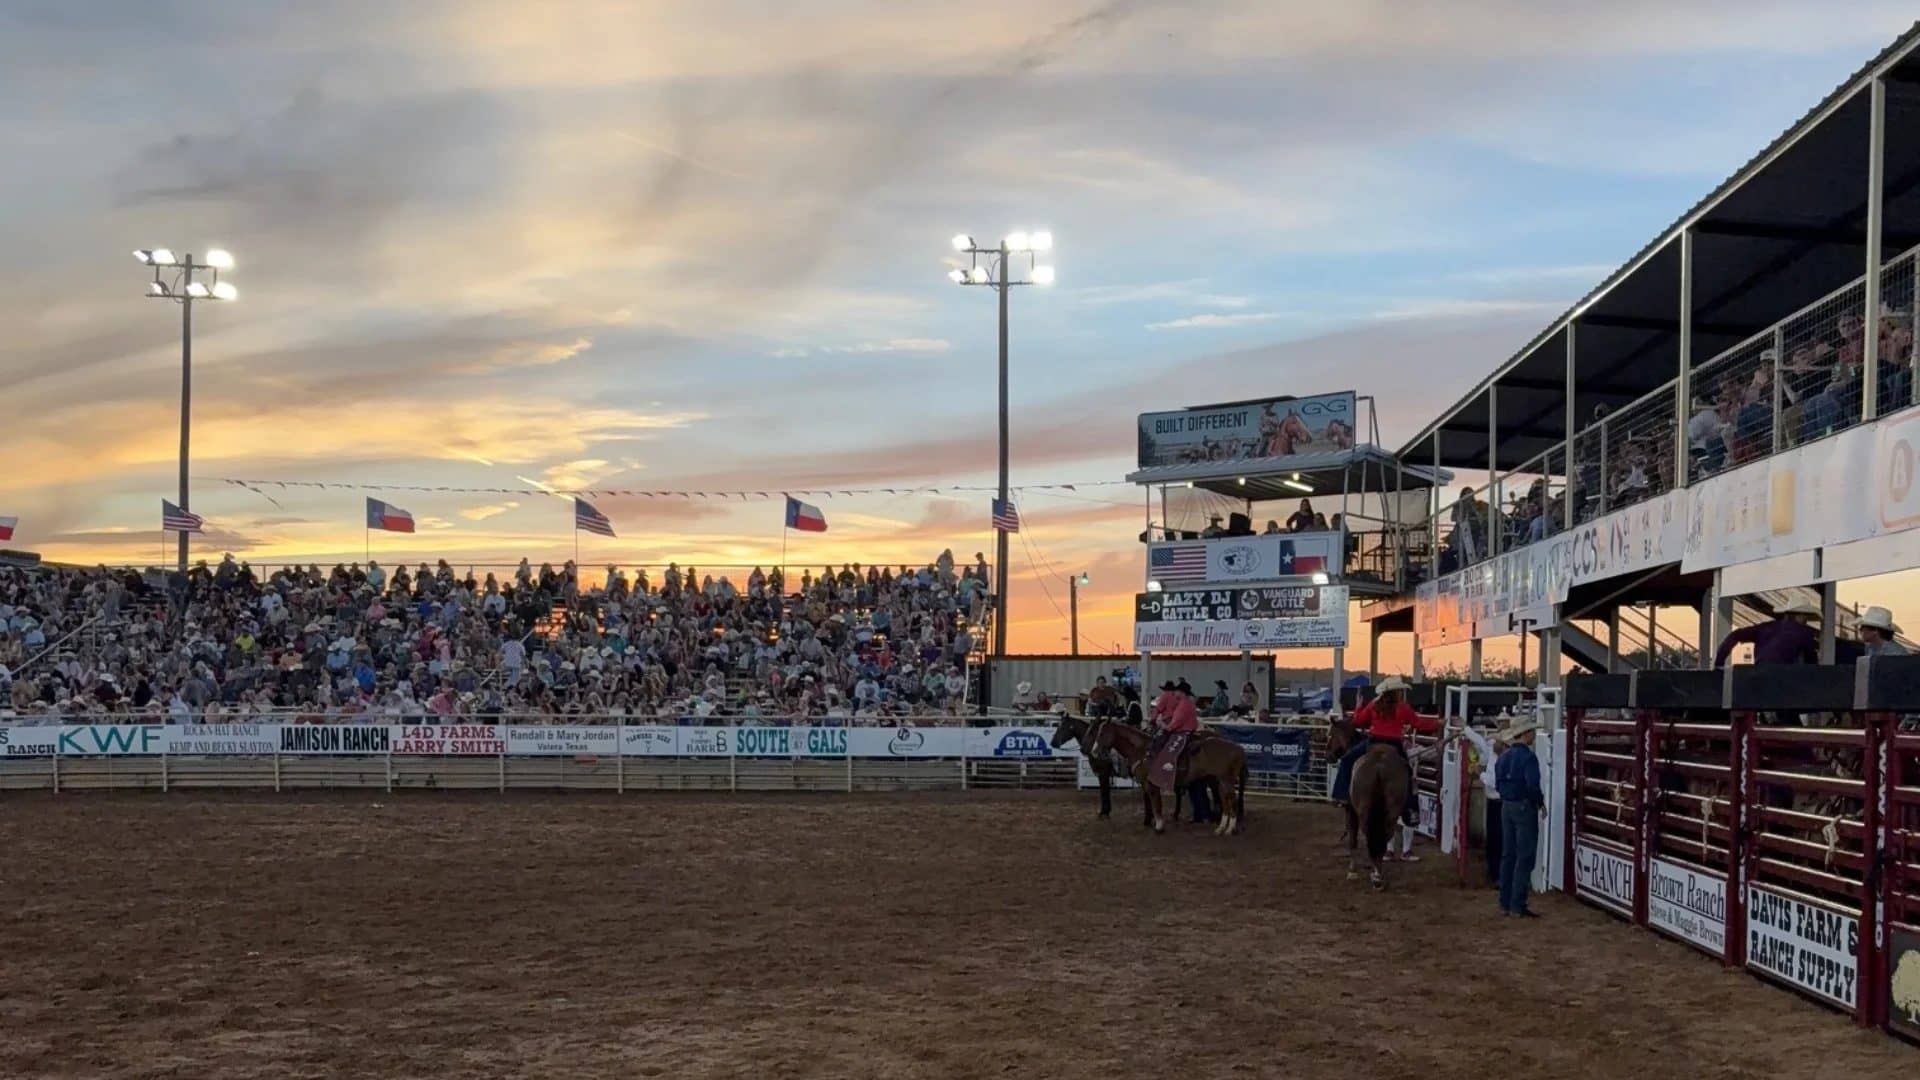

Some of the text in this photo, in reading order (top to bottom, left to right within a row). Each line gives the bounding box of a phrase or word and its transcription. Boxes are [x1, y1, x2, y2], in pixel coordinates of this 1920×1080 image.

[1155, 411, 1249, 434] BUILT DIFFERENT
[1162, 591, 1232, 606] LAZY DJ
[1262, 588, 1315, 600] VANGUARD
[1271, 597, 1306, 609] CATTLE
[1161, 605, 1232, 620] CATTLE CO
[1136, 626, 1175, 649] Lanham
[1181, 626, 1201, 647] Kim
[1203, 624, 1235, 646] Horne
[232, 725, 260, 736] RANCH
[401, 726, 496, 739] L4D FARMS
[510, 729, 545, 740] Randall
[556, 730, 580, 742] Mary
[583, 730, 615, 741] Jordan
[58, 726, 164, 753] KWF
[169, 741, 192, 752] KEMP
[194, 741, 210, 752] AND
[280, 727, 389, 751] JAMISON RANCH
[393, 740, 505, 753] LARRY SMITH
[737, 729, 789, 753] SOUTH
[807, 729, 848, 754] GALS
[1005, 737, 1040, 749] BTW
[7, 744, 56, 754] RANCH
[565, 743, 588, 751] Texas
[1576, 852, 1634, 900] S-RANCH
[1651, 862, 1724, 920] Brown Ranch
[1750, 889, 1792, 933] DAVIS
[1796, 901, 1842, 951] FARM
[1699, 919, 1723, 946] Brown
[1751, 930, 1855, 1004] RANCH SUPPLY
